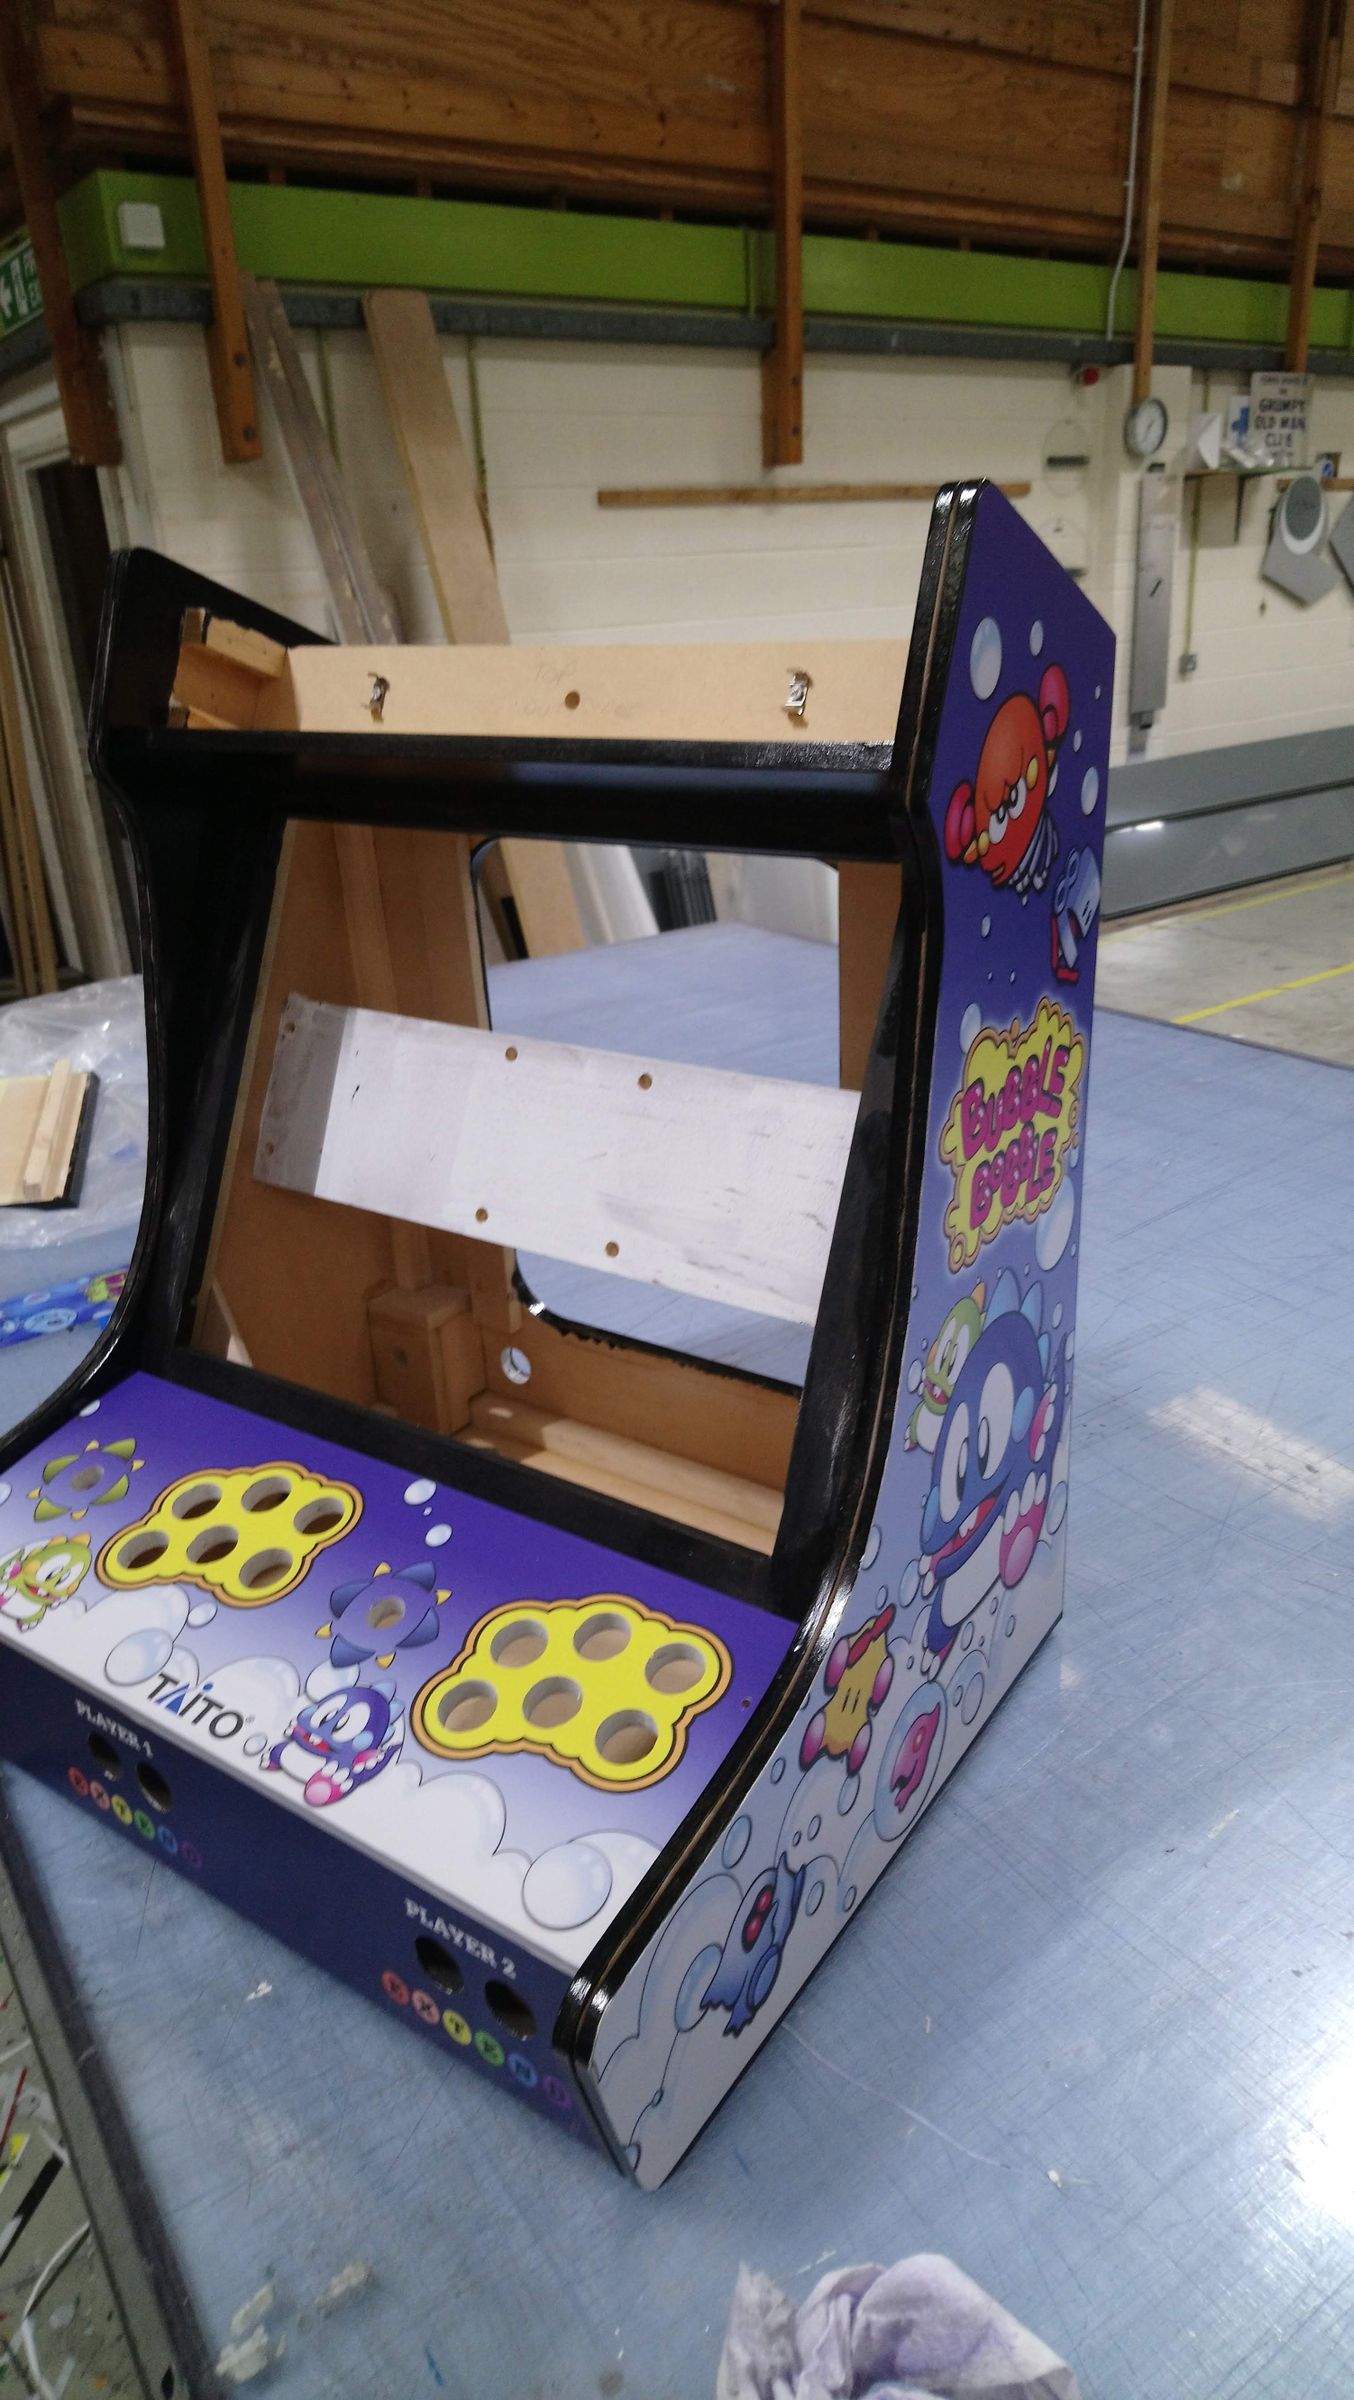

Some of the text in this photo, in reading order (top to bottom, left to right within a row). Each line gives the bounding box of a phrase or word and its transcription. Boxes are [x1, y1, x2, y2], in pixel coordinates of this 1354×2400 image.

[1254, 415, 1276, 431] OLD
[961, 1036, 1070, 1161] BUBBLE
[970, 1121, 1058, 1231] BOBBLE
[74, 1698, 155, 1760] PLAYER 1
[403, 1897, 517, 1980] PLAYER 2
